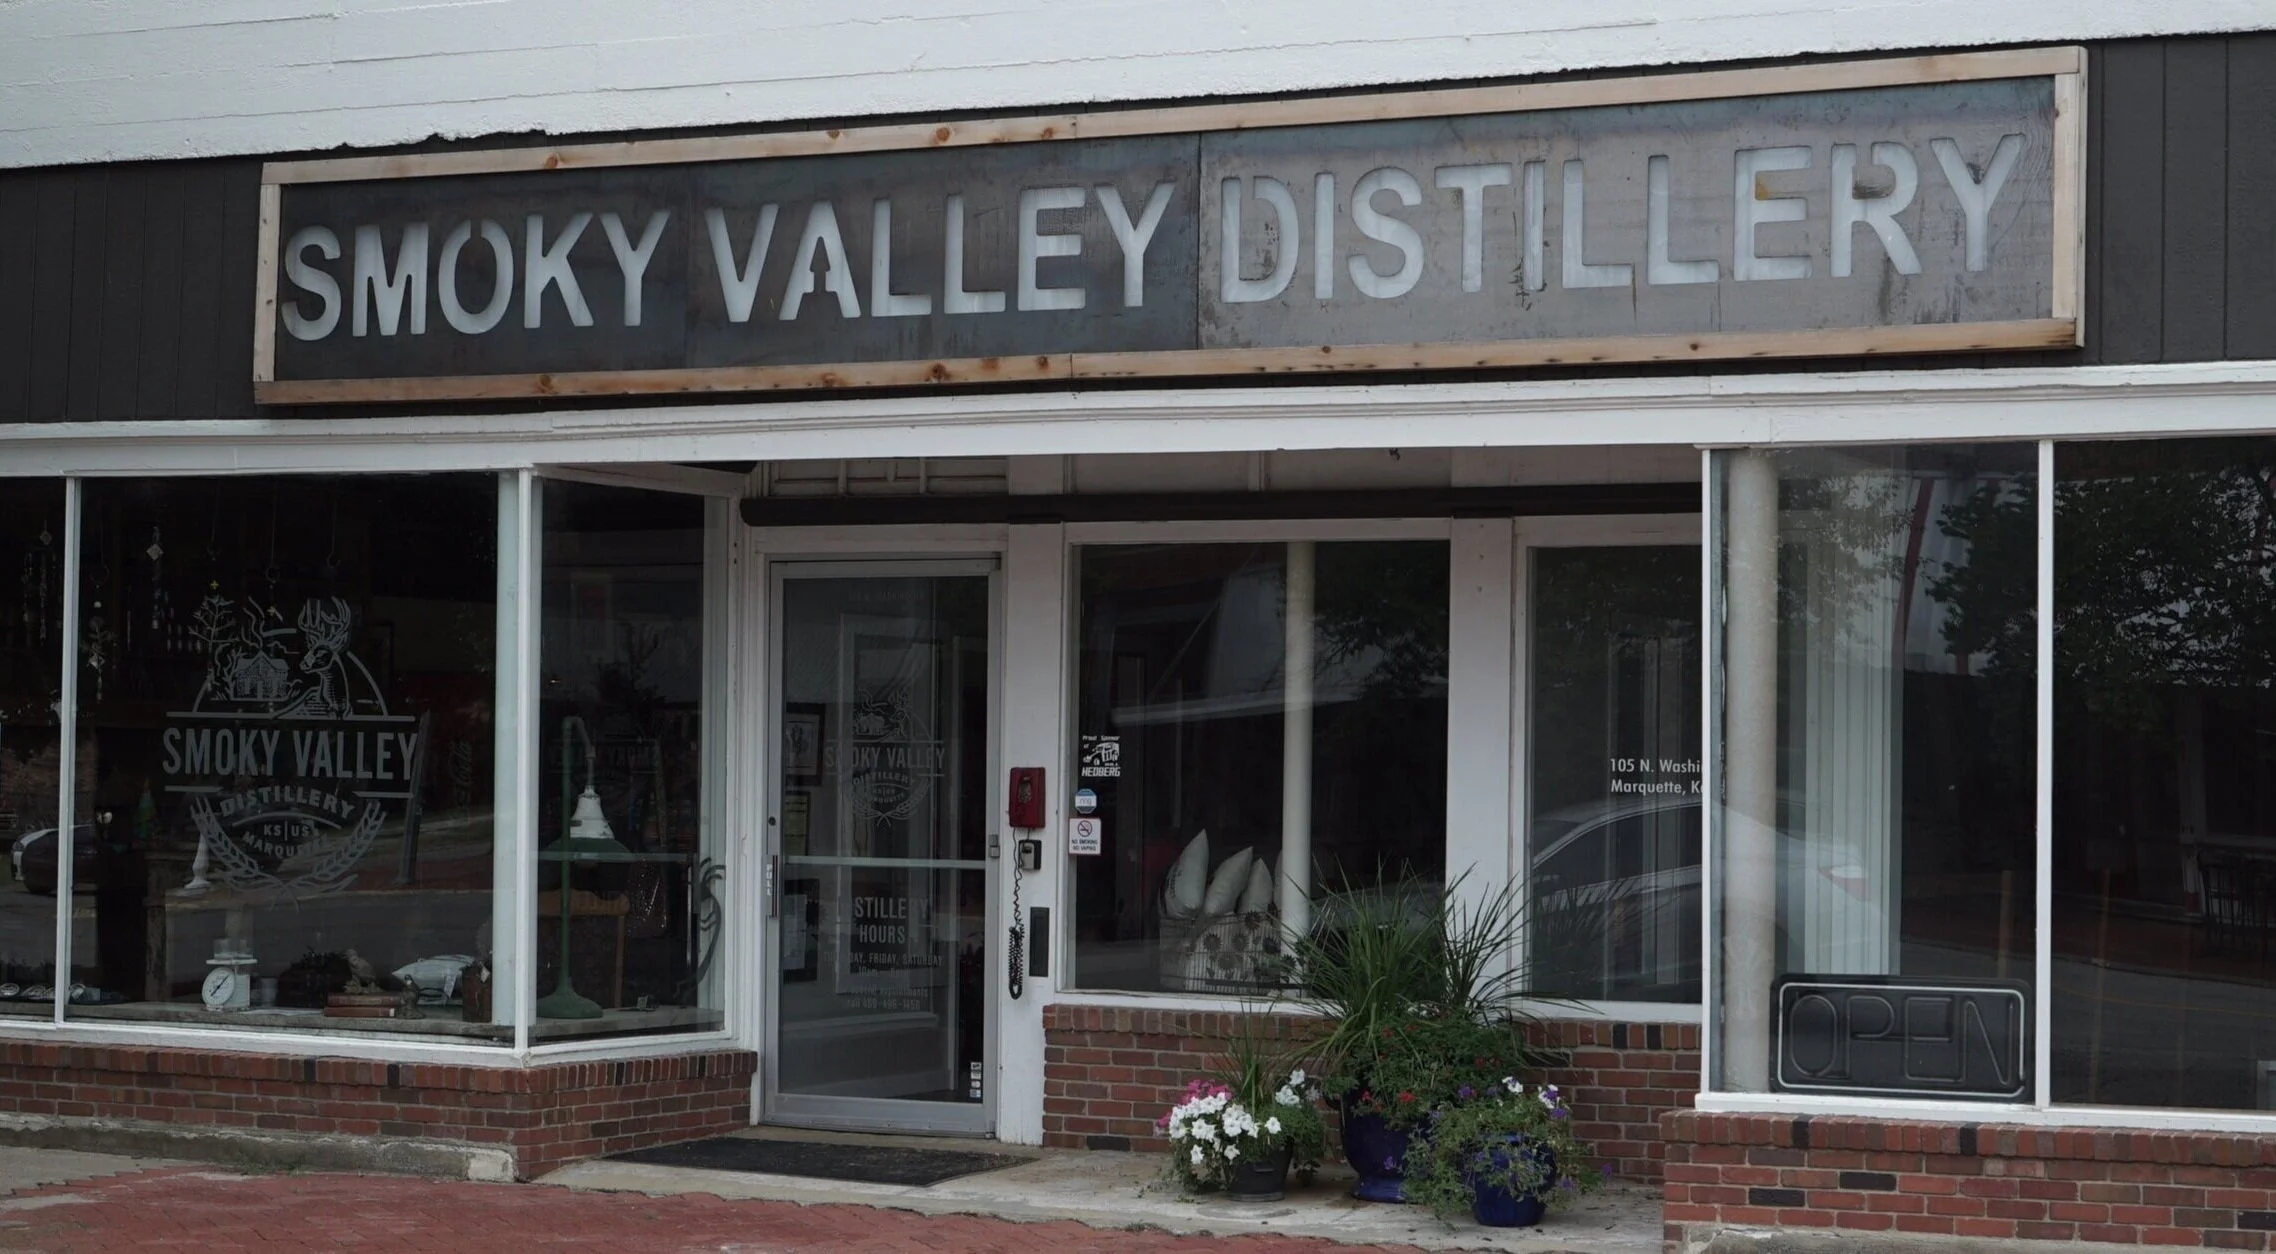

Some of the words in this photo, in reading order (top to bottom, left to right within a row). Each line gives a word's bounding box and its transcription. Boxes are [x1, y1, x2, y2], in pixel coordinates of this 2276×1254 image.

[281, 209, 670, 341] SMOKY
[705, 182, 1176, 324] VALLEY
[1221, 132, 2028, 303] DISTILLERY
[162, 727, 280, 777] SMOKY
[292, 730, 418, 781] VALLEY
[825, 746, 881, 769] SOKY
[1610, 758, 1635, 772] 105
[1639, 759, 1654, 773] N.
[1659, 758, 1702, 773] Washi
[1081, 766, 1121, 777] HEDBERG
[1610, 778, 1686, 797] Marquette,
[1691, 780, 1703, 794] K
[219, 784, 356, 820] DISTILLERY
[859, 924, 906, 944] HOURS
[1789, 994, 2015, 1087] OPEN
